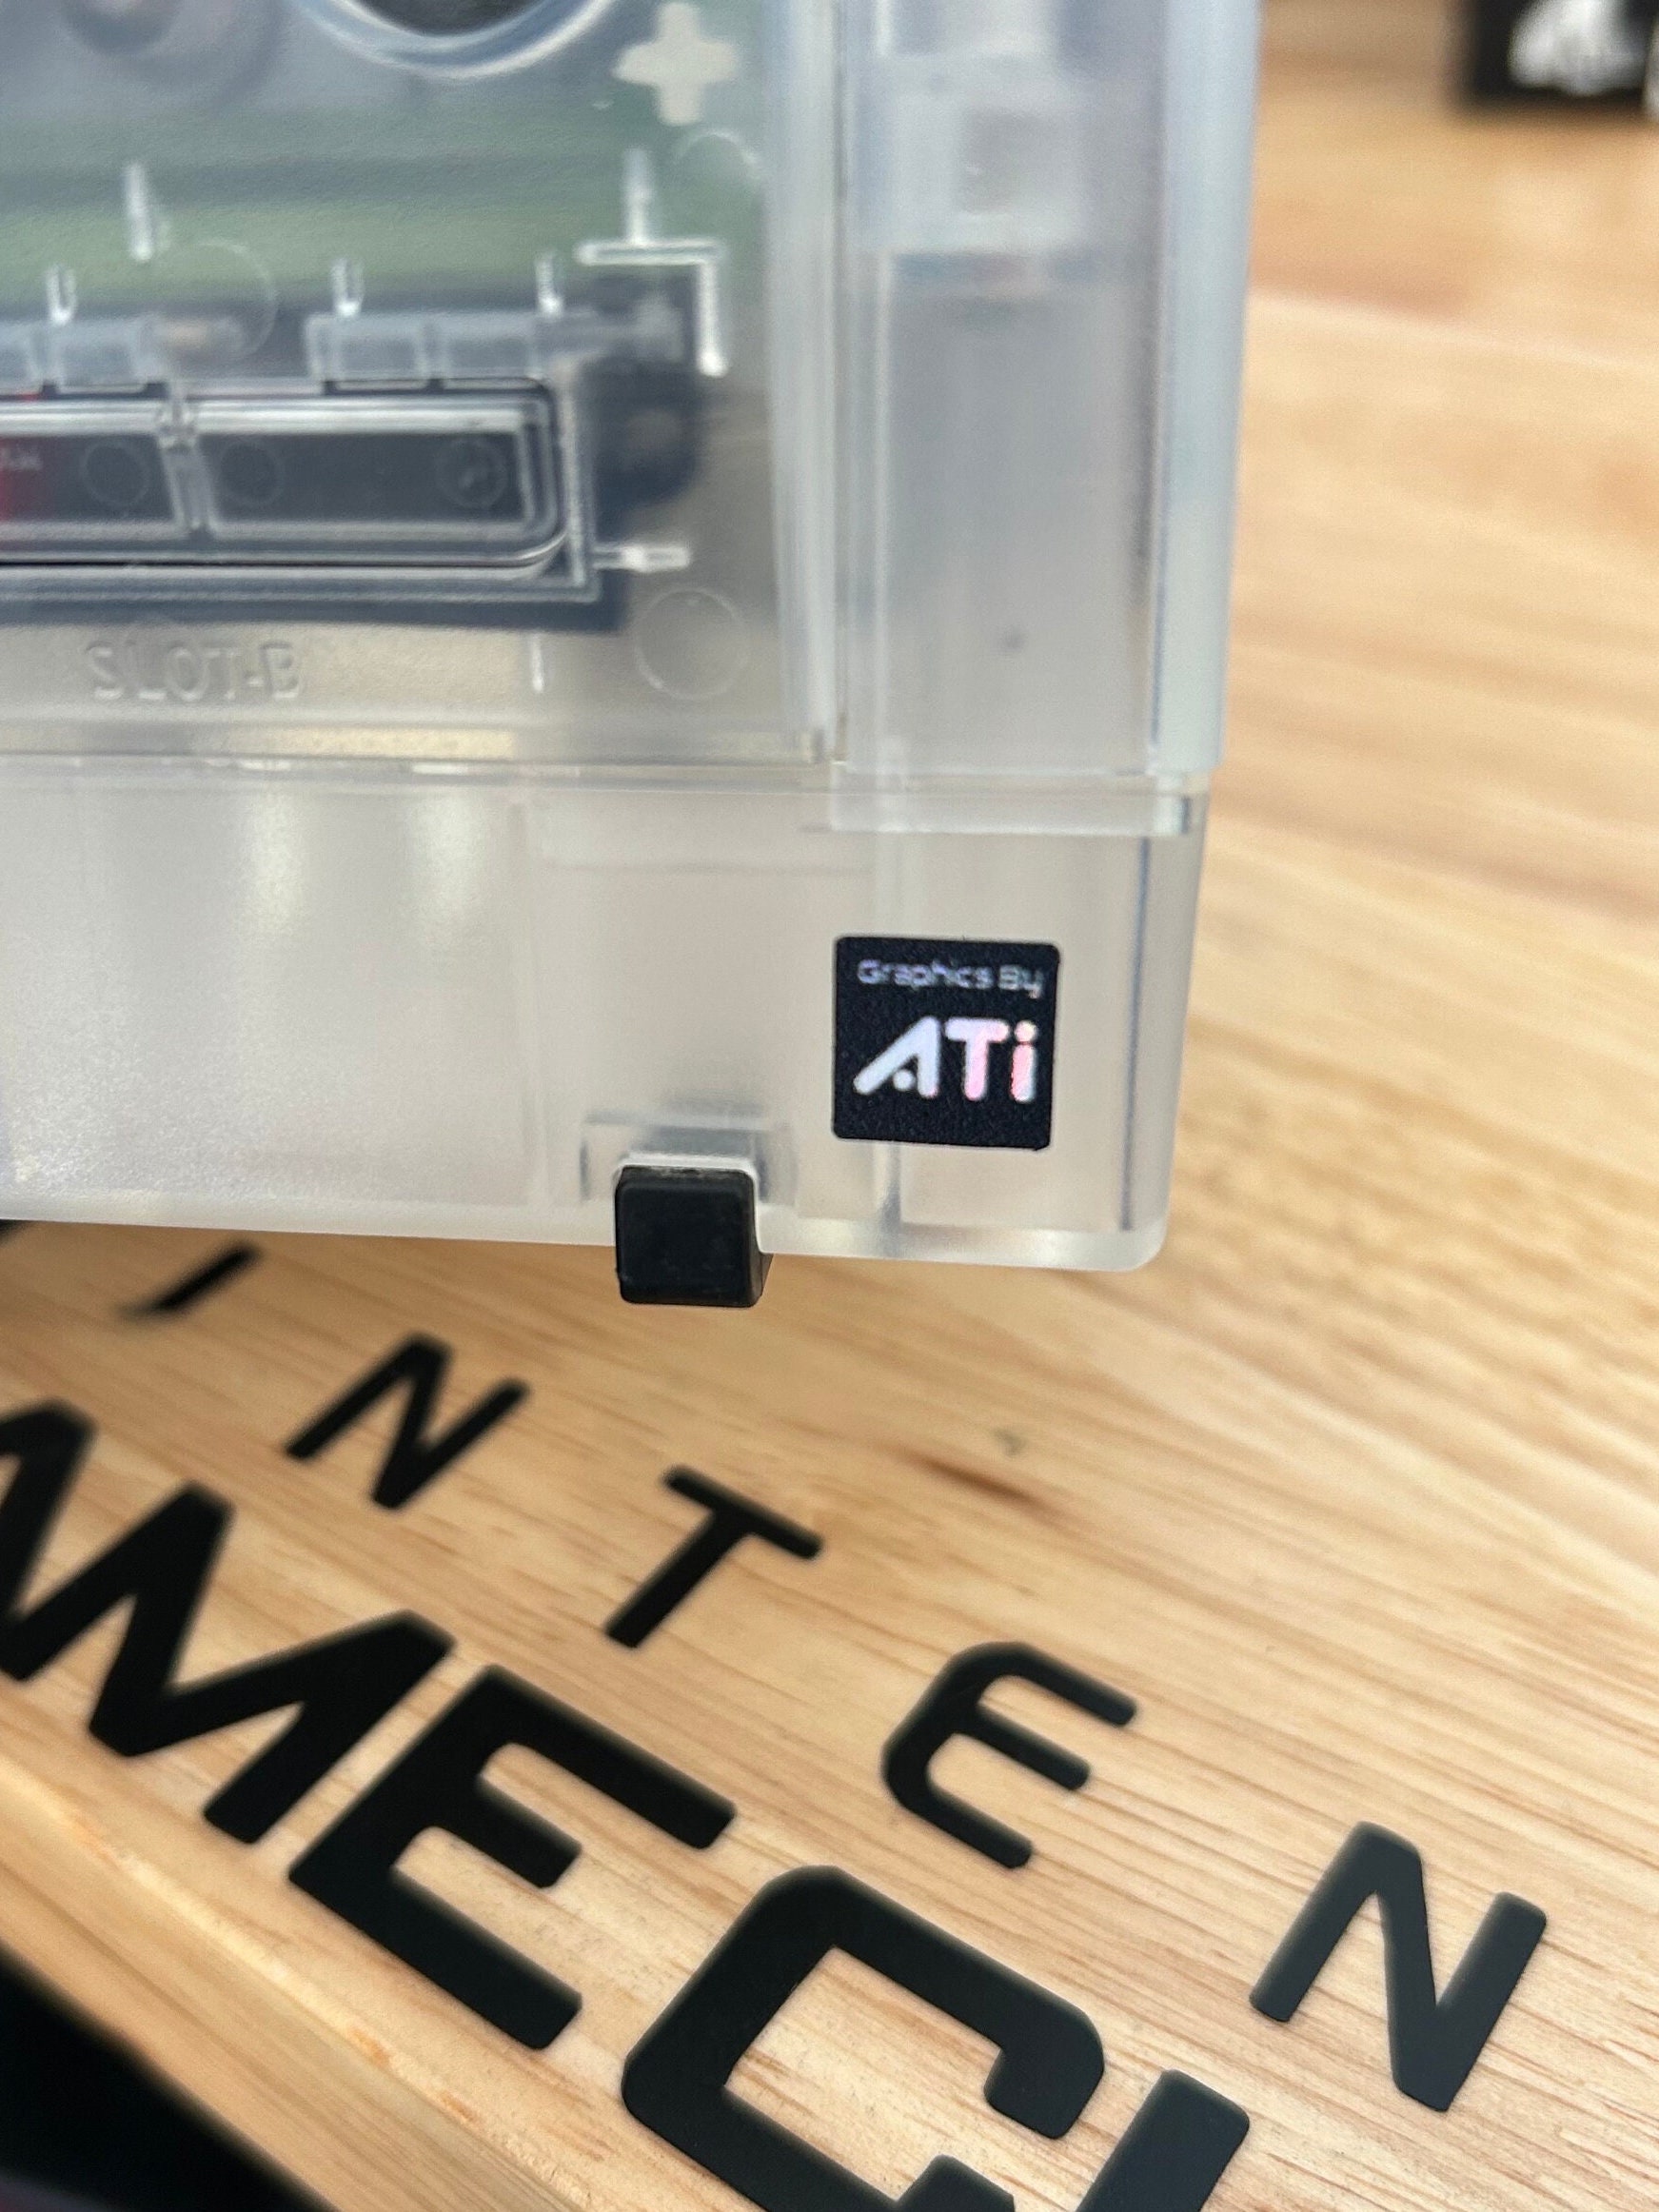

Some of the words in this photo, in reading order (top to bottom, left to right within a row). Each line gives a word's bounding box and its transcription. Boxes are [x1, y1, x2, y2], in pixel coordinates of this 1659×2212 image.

[87, 641, 302, 701] SLOT-B
[858, 958, 995, 992] Graphics
[997, 964, 1044, 999] By
[853, 1016, 1038, 1103] ATi
